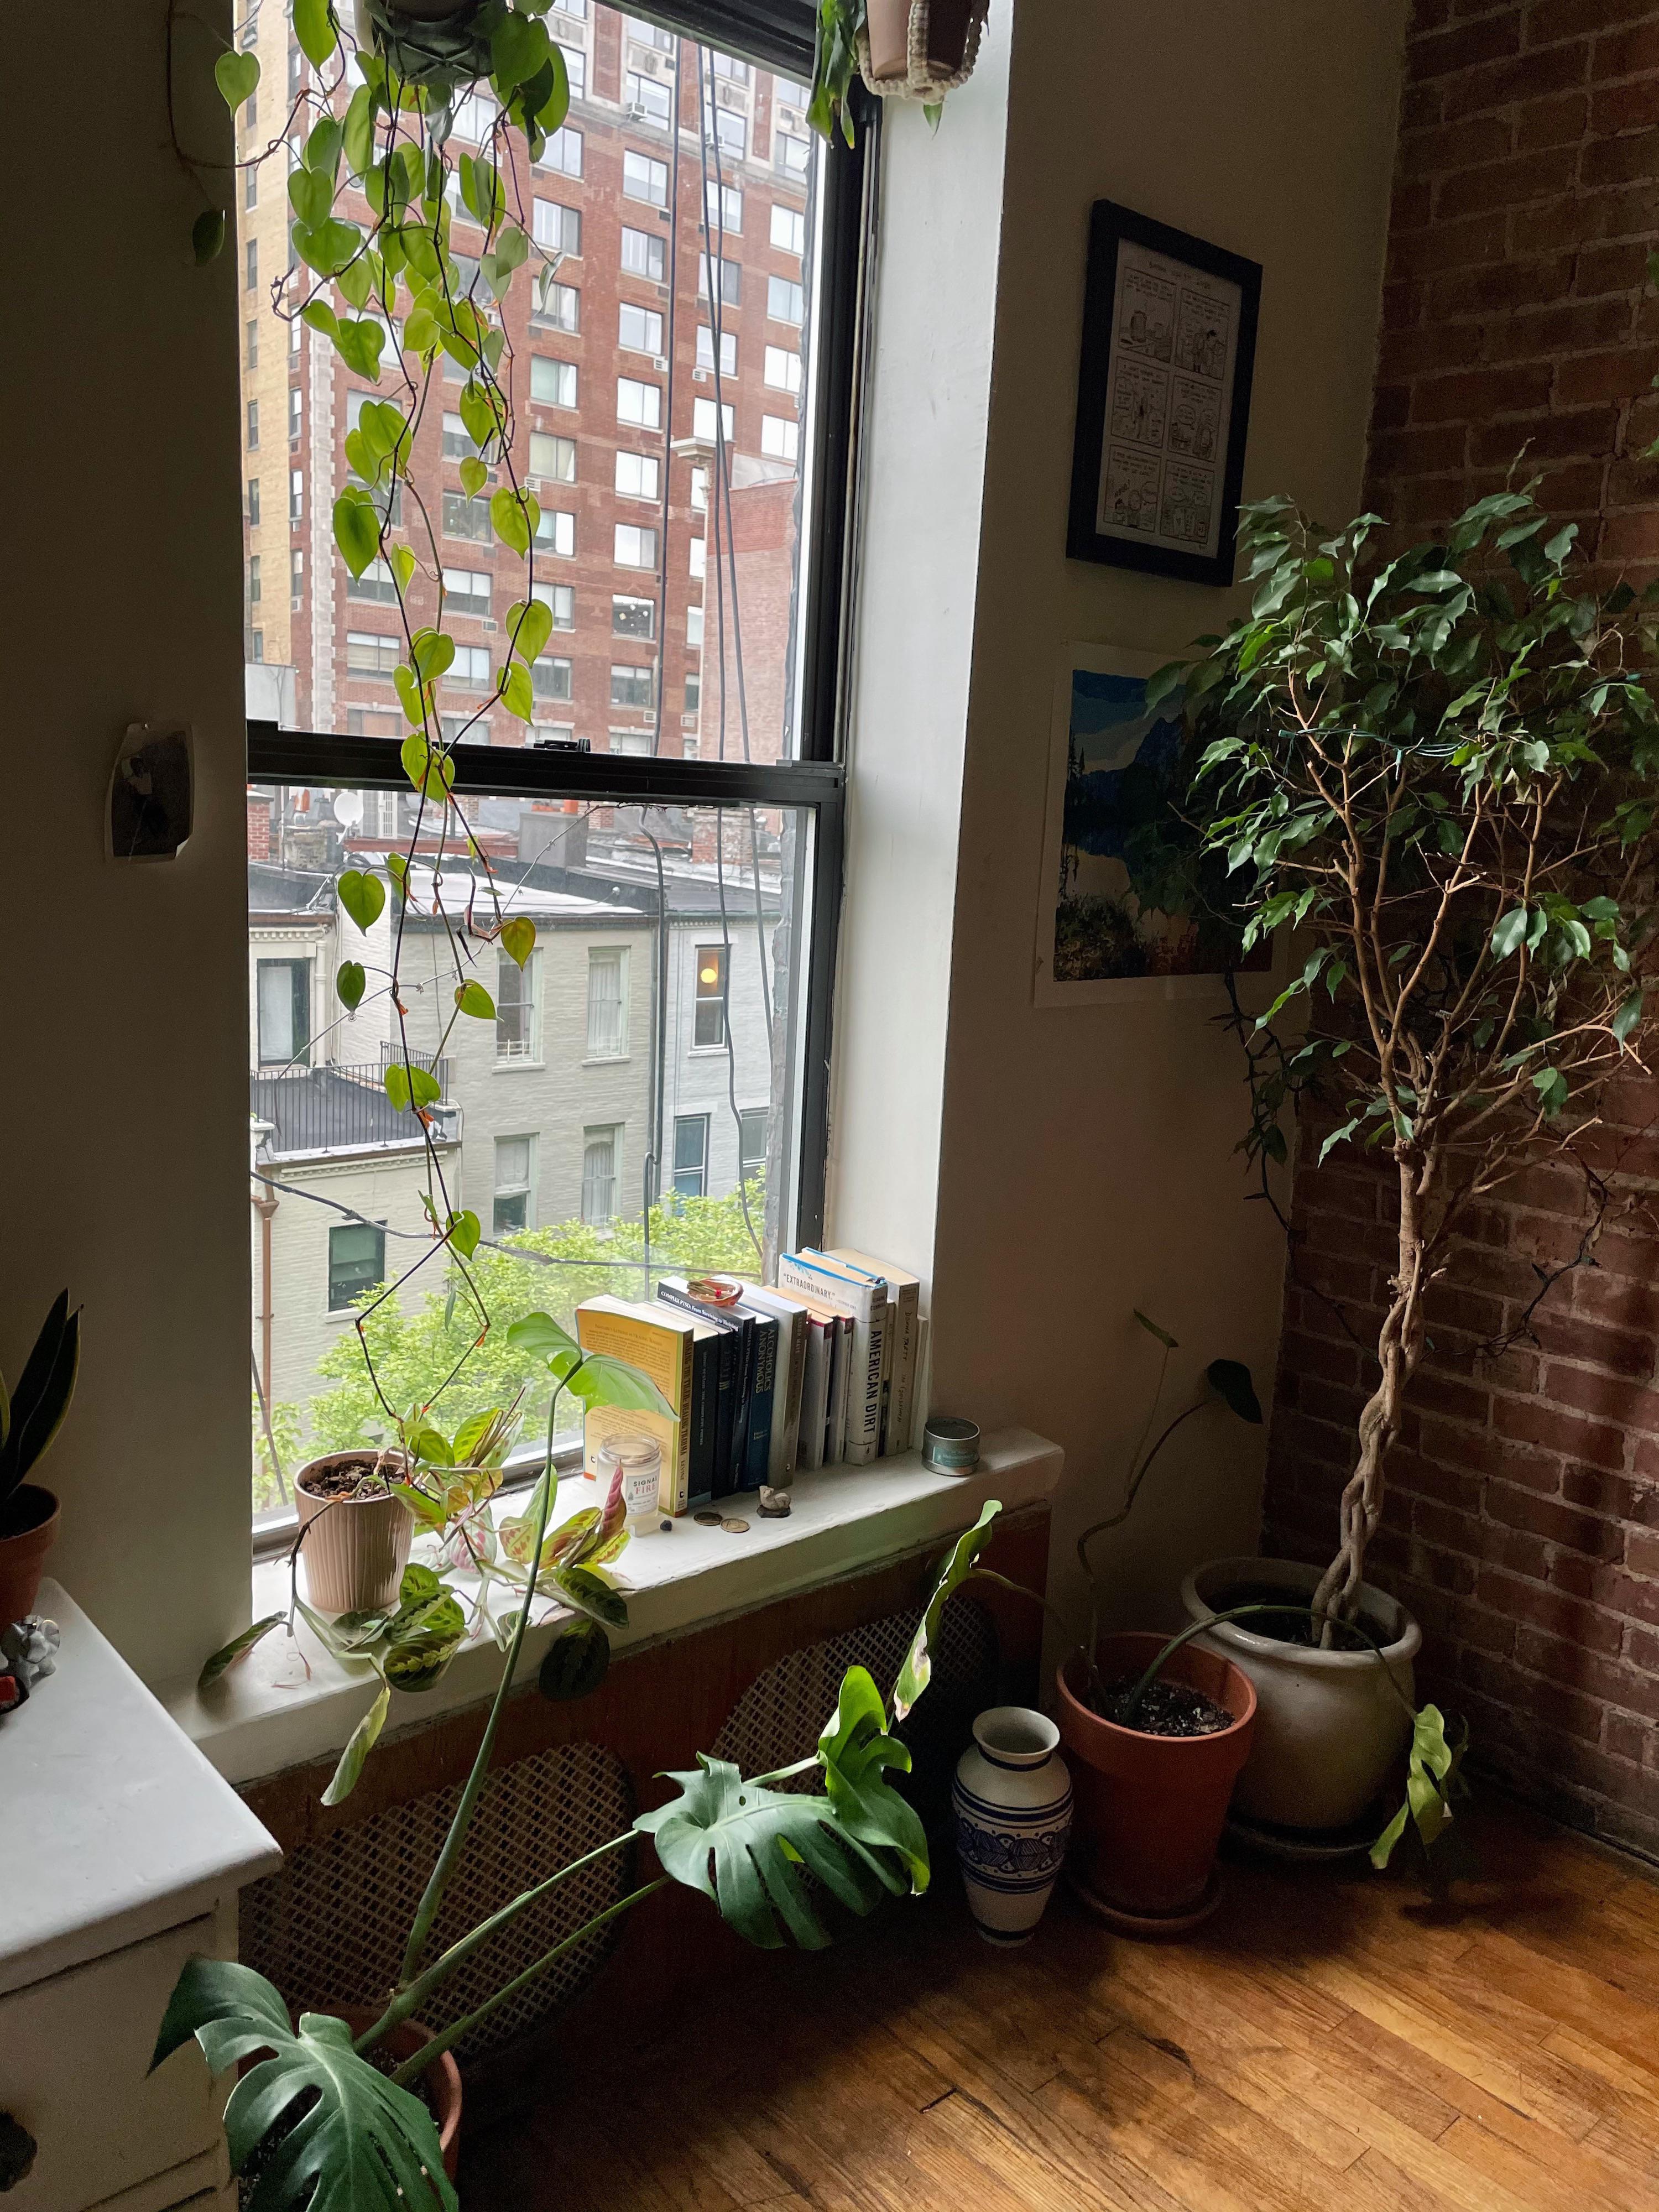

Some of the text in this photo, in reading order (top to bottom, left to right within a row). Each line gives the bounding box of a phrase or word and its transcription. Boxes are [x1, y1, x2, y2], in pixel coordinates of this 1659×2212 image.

[660, 1291, 680, 1304] COMPLEX
[691, 1305, 702, 1314] From
[702, 1309, 718, 1322] Surviving
[755, 1331, 768, 1394] ANONYMOUS
[764, 1328, 775, 1391] ALCOHOLICS
[864, 1330, 882, 1433] AMERICAN DIRT
[633, 1475, 657, 1487] SIGNAL
[635, 1484, 656, 1495] FIRE
